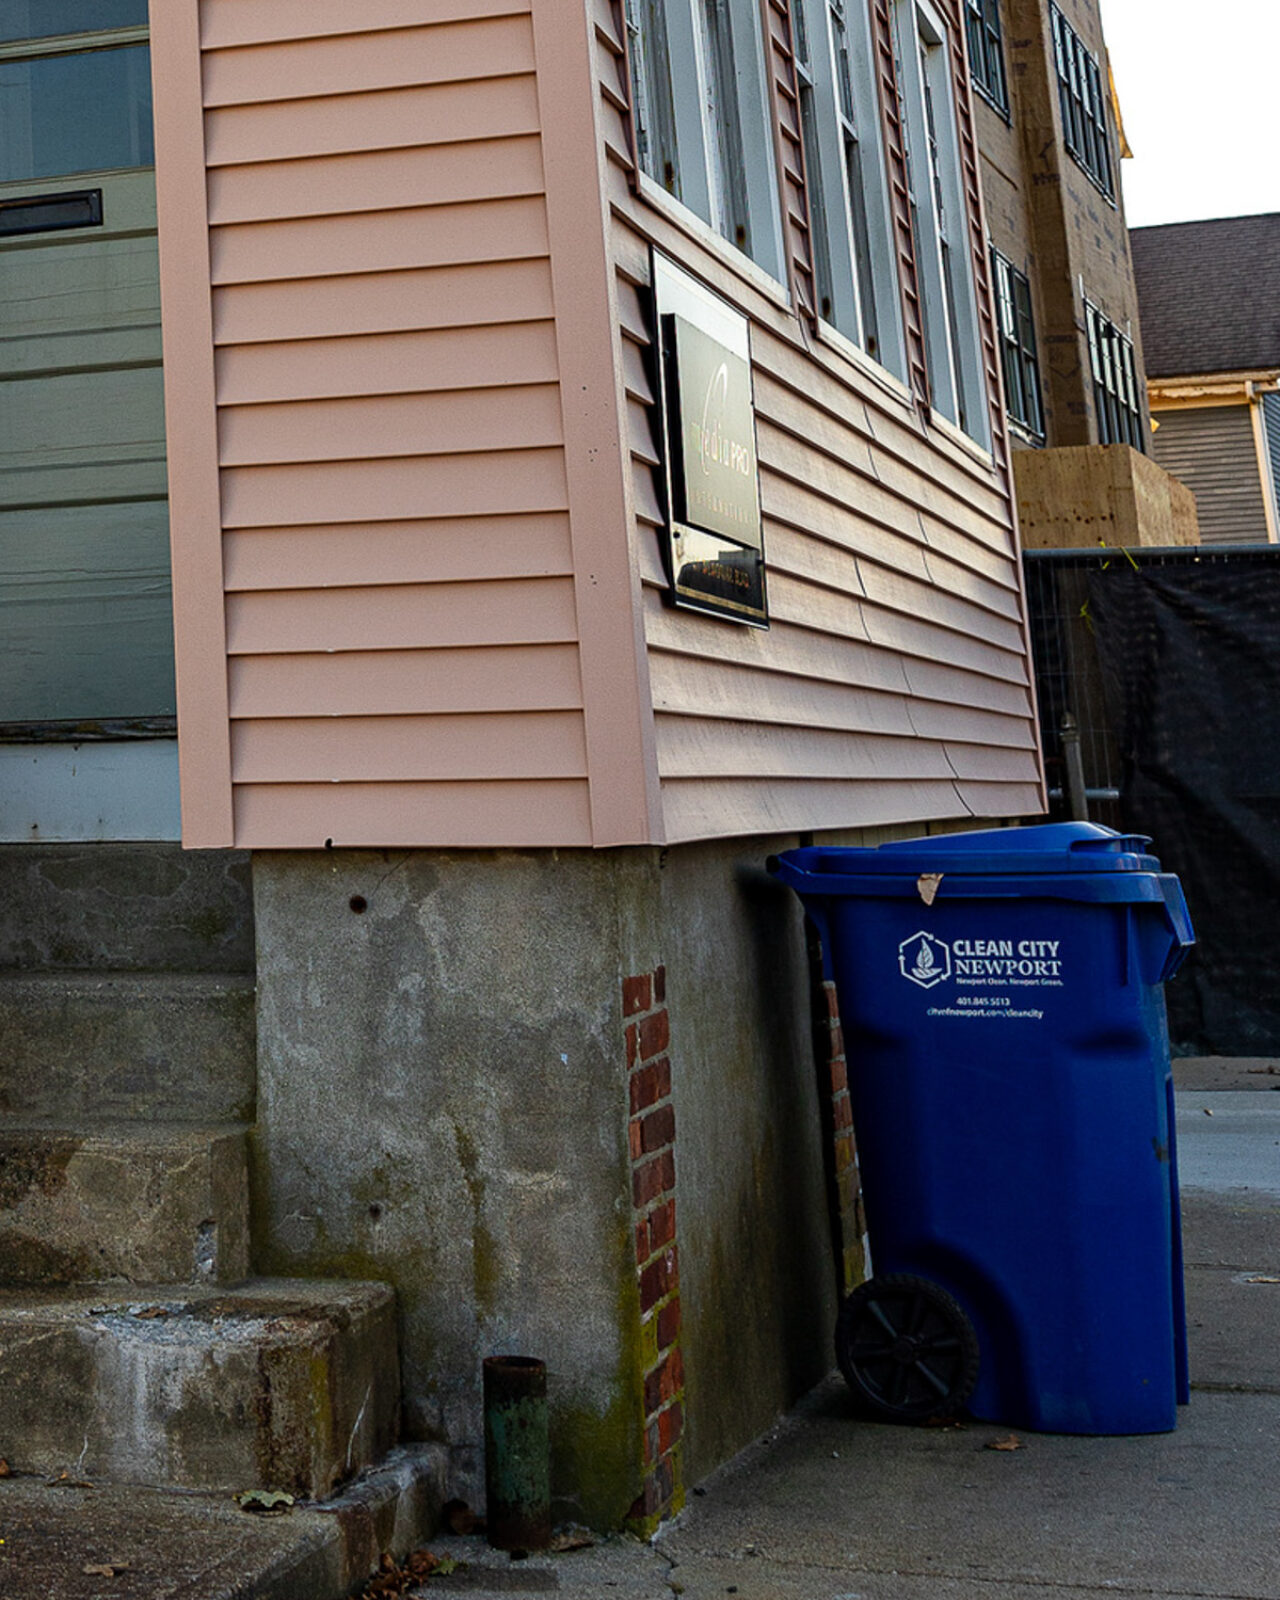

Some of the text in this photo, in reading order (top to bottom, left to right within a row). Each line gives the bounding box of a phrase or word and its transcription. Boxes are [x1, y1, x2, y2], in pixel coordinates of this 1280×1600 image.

[953, 940, 1060, 958] CLEAN CITY
[954, 959, 1062, 976] NEWPORT
